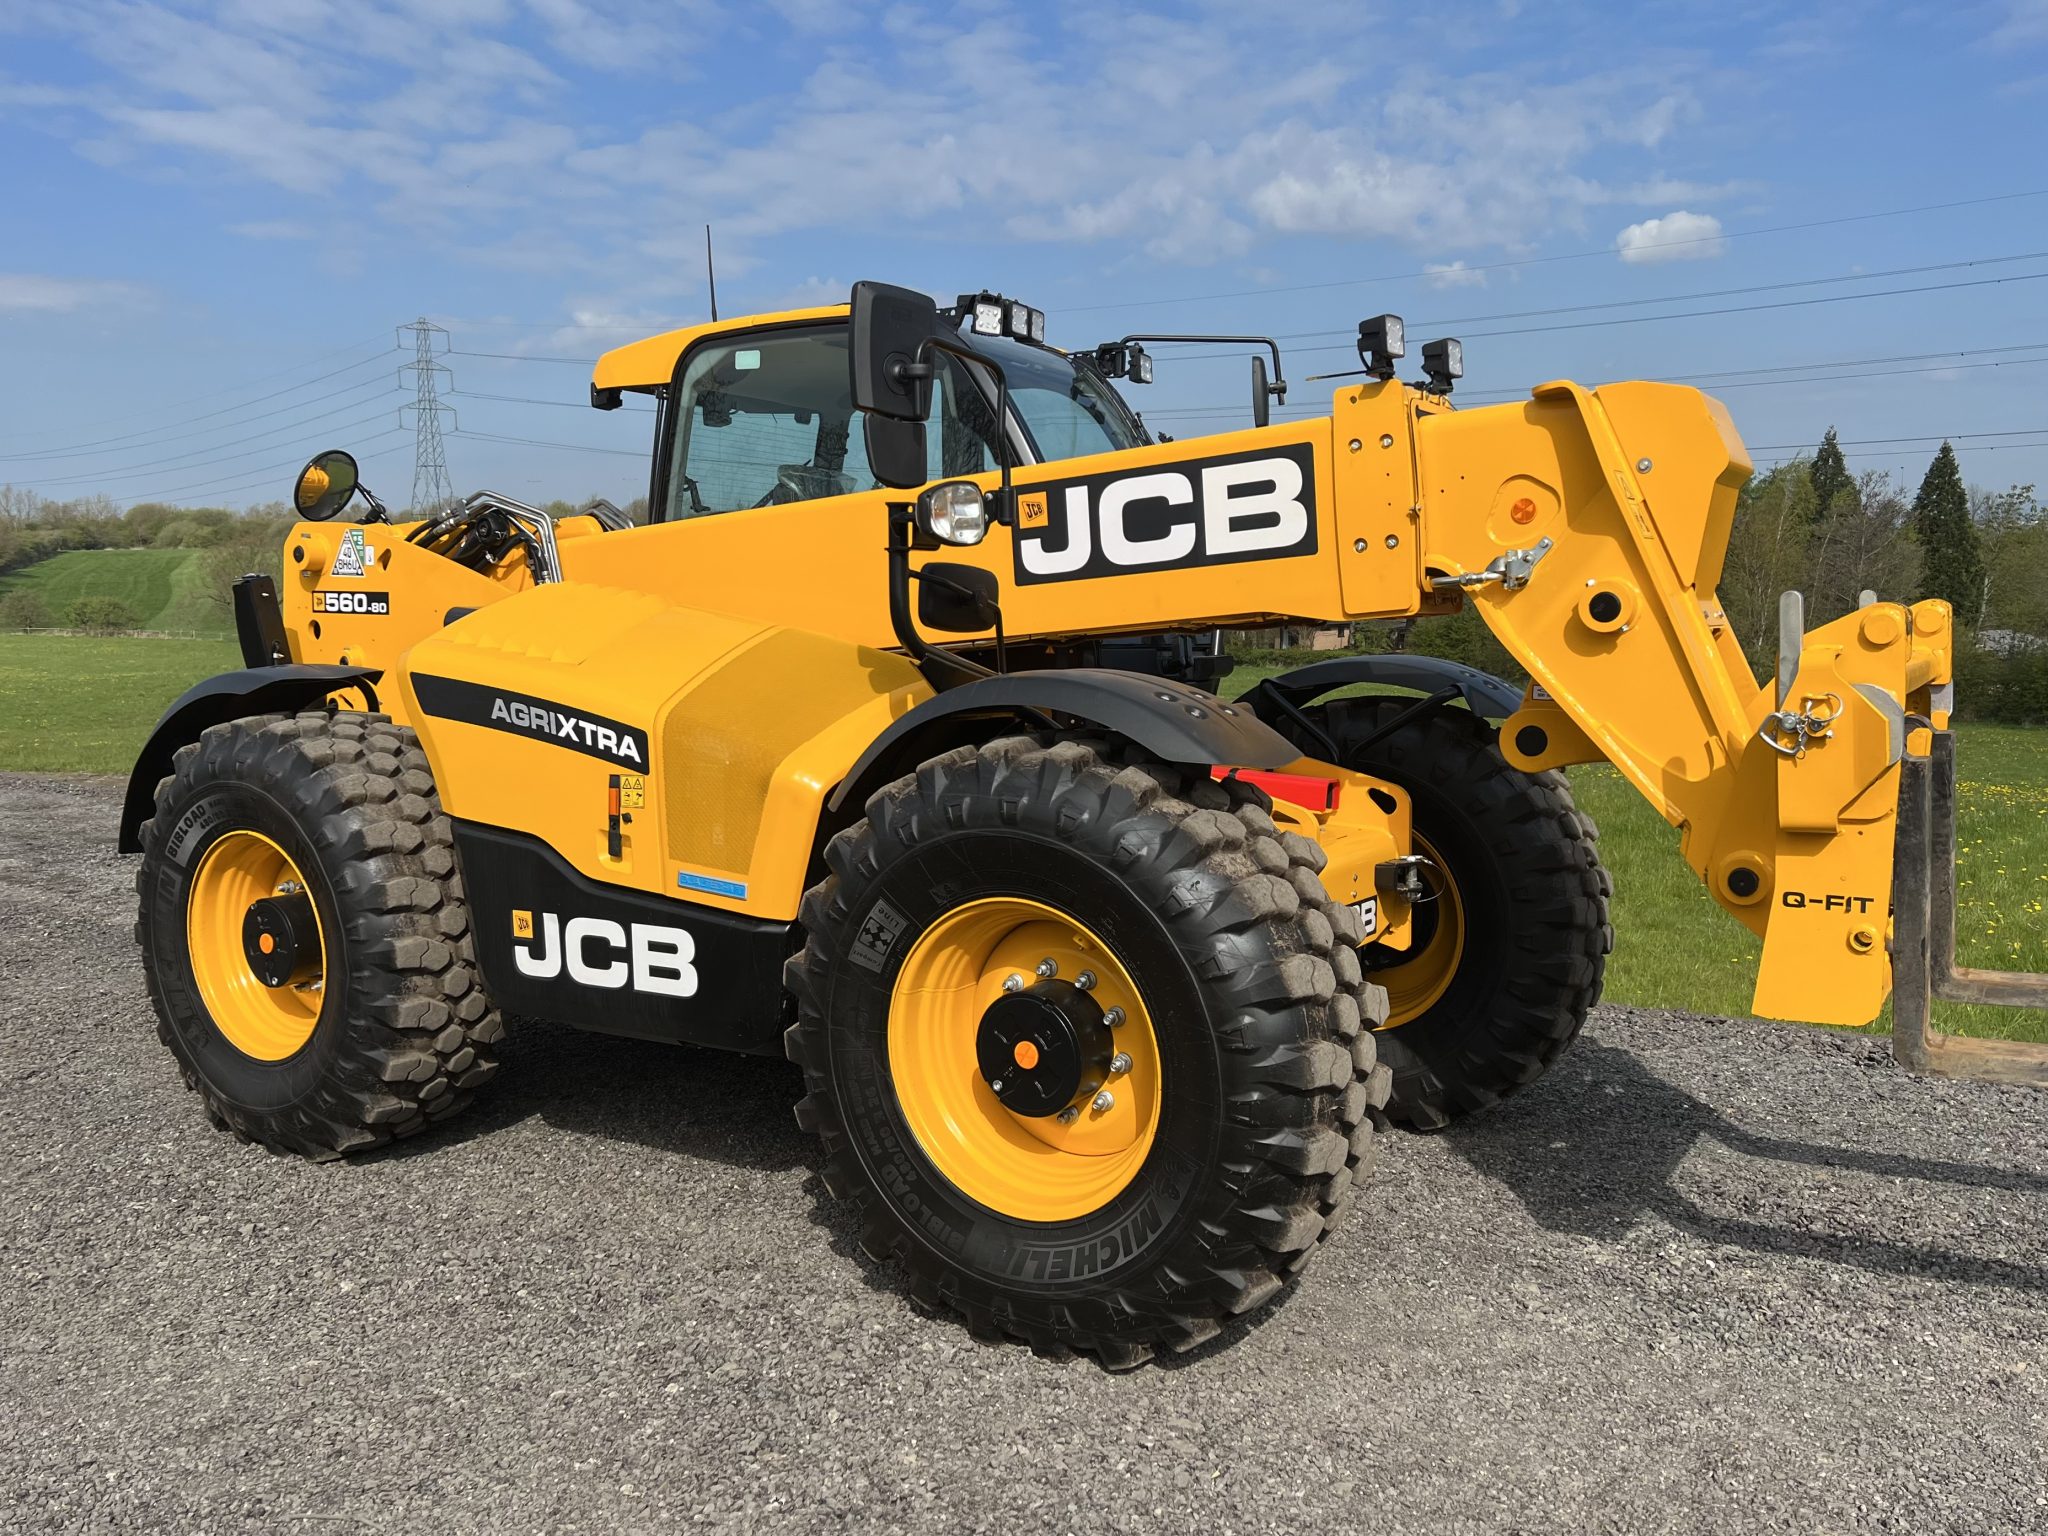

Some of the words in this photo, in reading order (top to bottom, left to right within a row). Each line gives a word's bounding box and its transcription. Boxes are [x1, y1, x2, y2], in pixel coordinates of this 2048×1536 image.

[1020, 457, 1308, 575] JCB
[1026, 503, 1043, 518] JCB
[491, 697, 642, 763] AGRIXTRA
[167, 803, 206, 859] BIBLOAD
[1782, 891, 1875, 914] Q-FIT
[514, 912, 698, 997] JCB
[878, 1163, 966, 1253] BIBLOAD
[990, 1201, 1164, 1281] MICHELI
